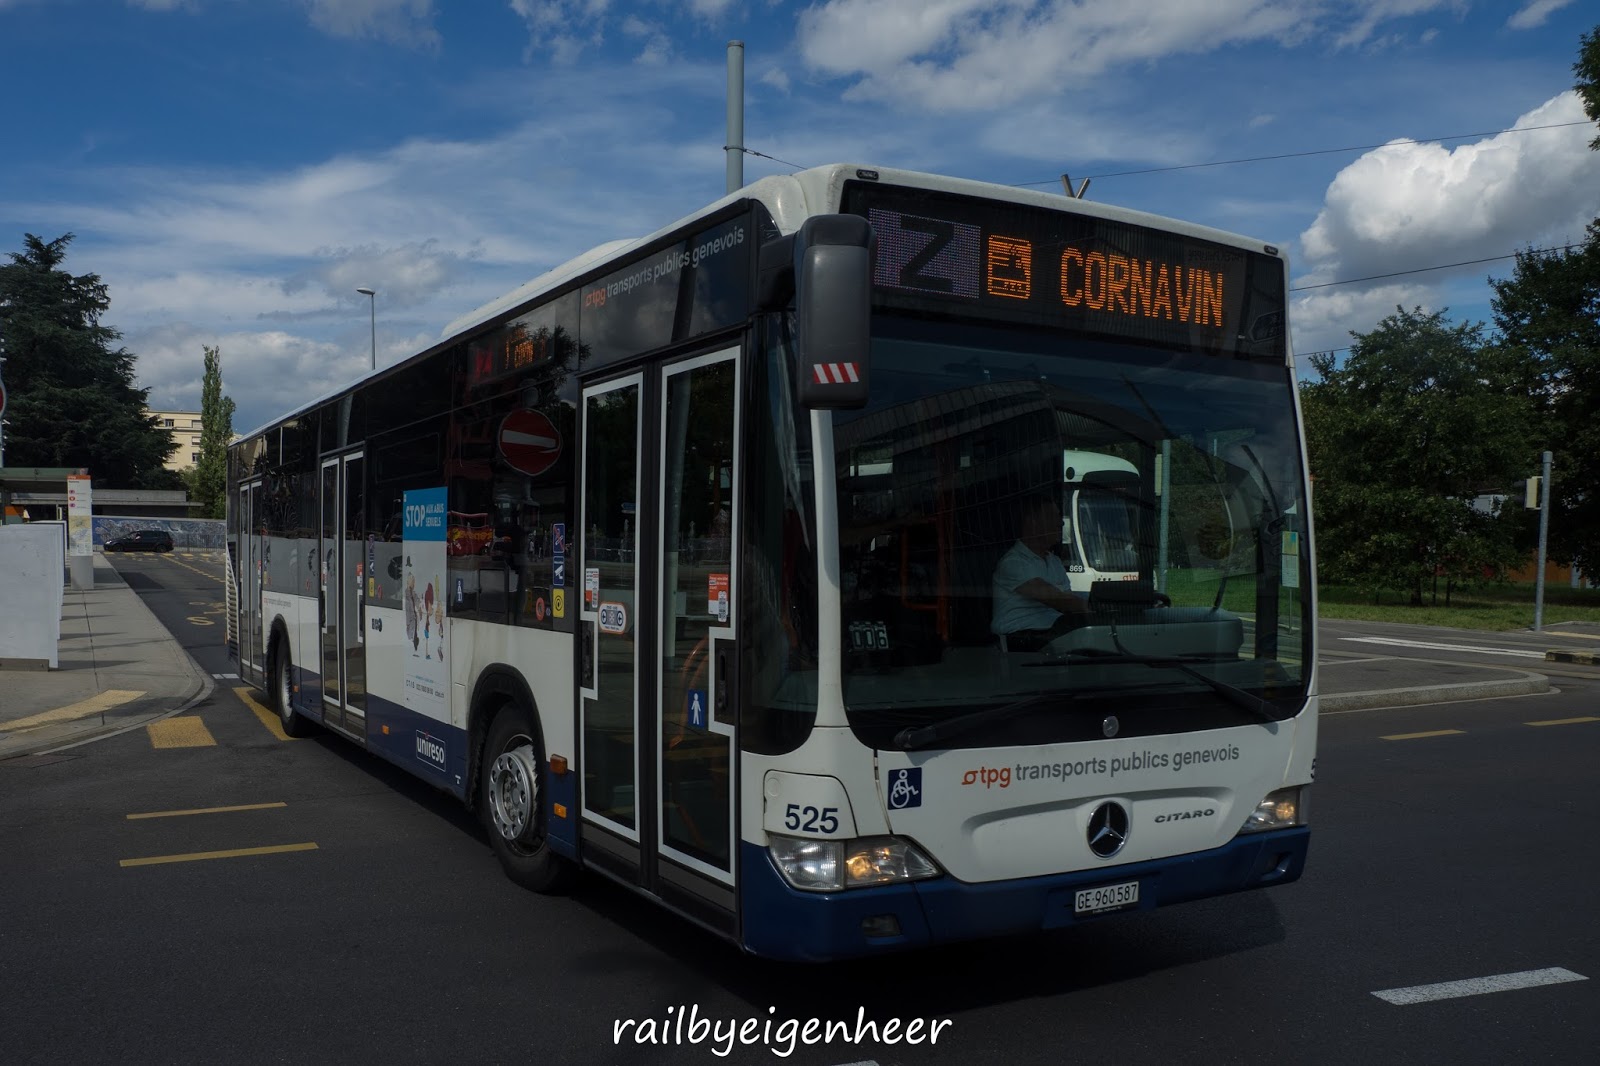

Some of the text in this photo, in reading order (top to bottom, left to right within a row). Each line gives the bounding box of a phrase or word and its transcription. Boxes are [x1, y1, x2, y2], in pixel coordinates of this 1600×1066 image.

[607, 266, 653, 298] transports
[653, 249, 690, 284] publics
[692, 225, 745, 268] genevois
[1060, 247, 1223, 328] CORNAVIN
[405, 504, 426, 528] STOP
[1069, 564, 1083, 573] 869
[416, 736, 445, 764] unireso
[1015, 757, 1106, 782] transports
[1110, 751, 1169, 778] publics
[1172, 744, 1239, 771] genevois
[785, 803, 839, 834] 525
[1154, 808, 1215, 824] CITARO
